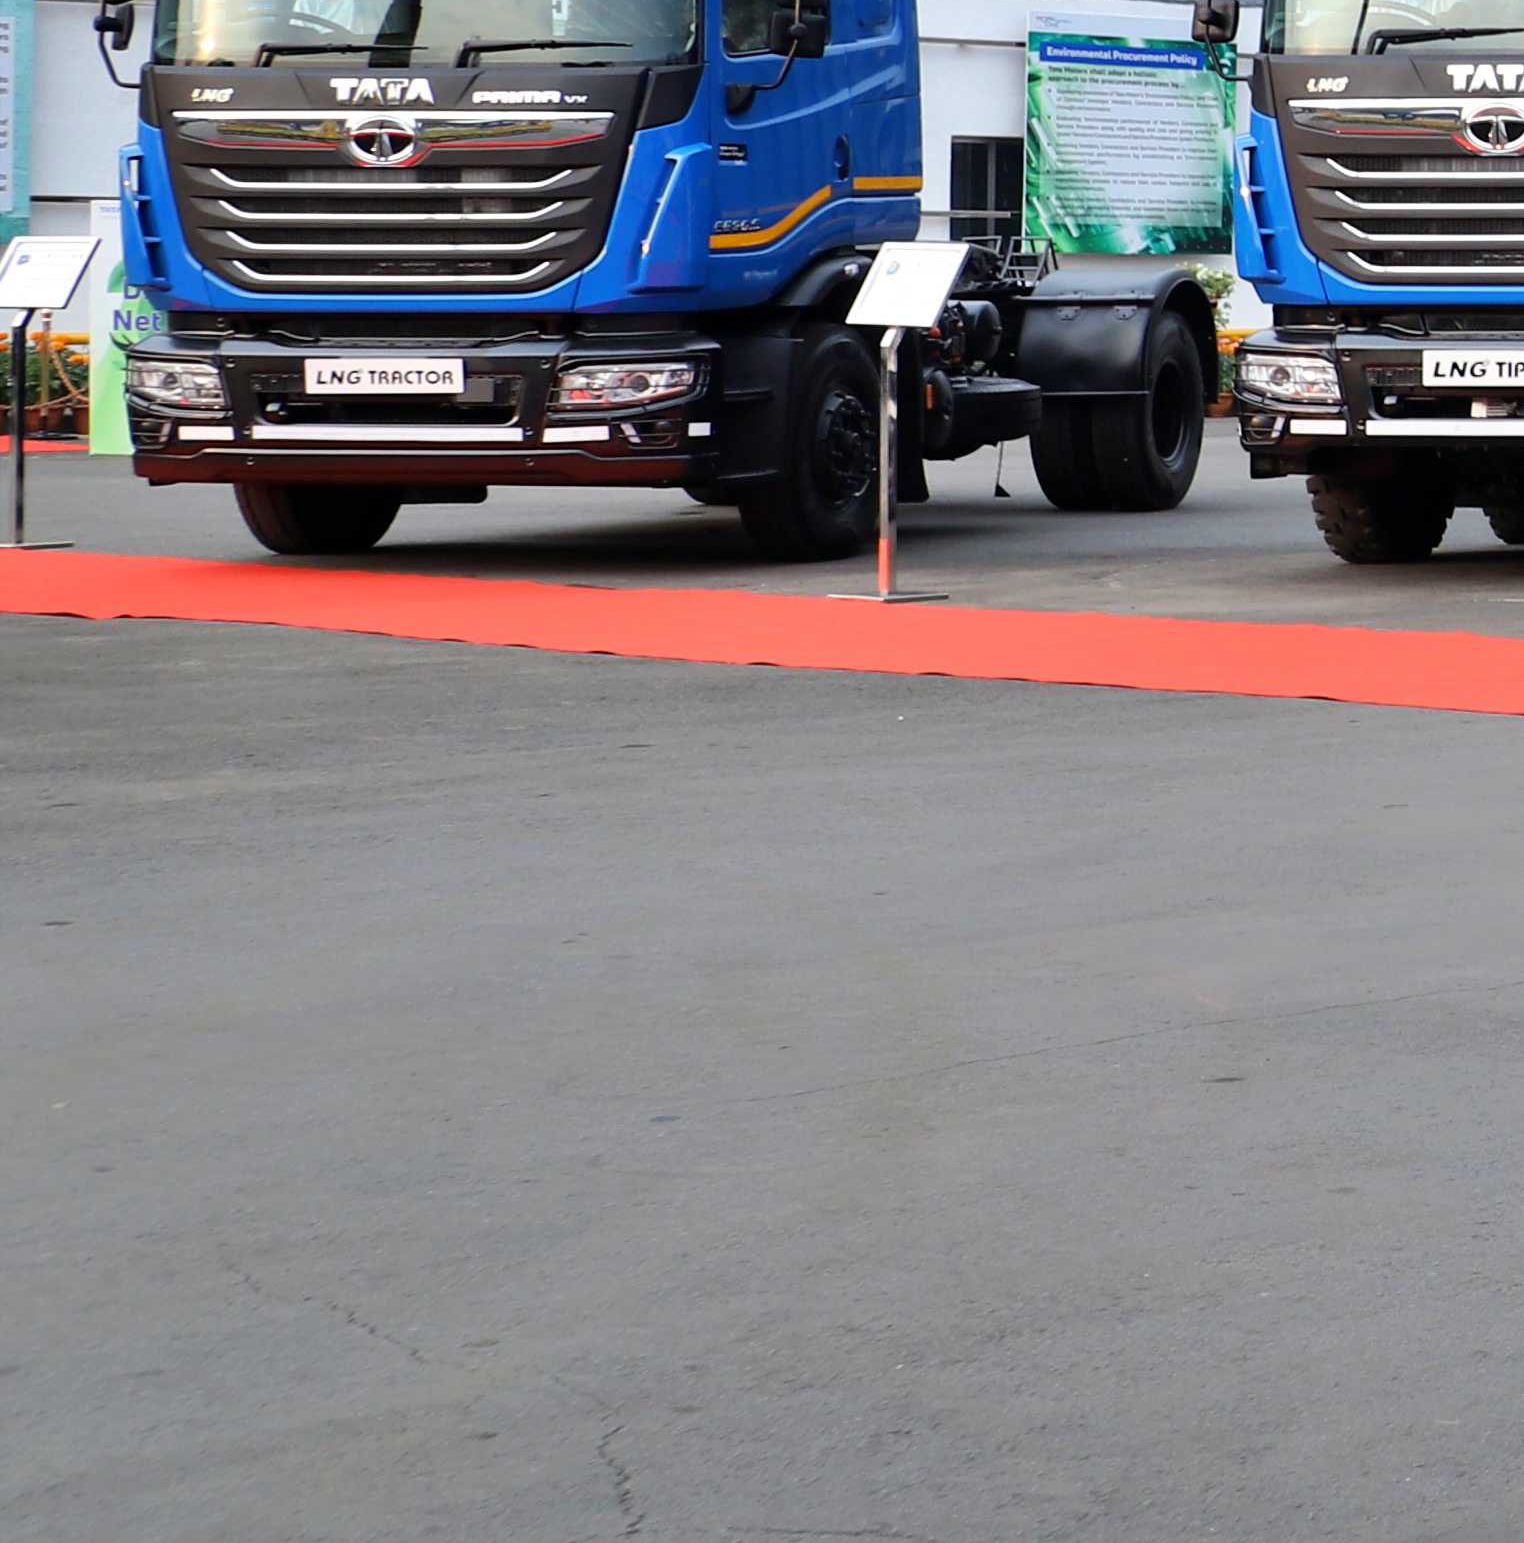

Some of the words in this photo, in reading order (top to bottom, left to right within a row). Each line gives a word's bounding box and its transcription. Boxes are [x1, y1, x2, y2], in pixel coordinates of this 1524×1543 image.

[1046, 46, 1113, 60] Environmental
[1113, 51, 1170, 63] Procurement
[1170, 53, 1198, 66] Policy
[330, 78, 435, 105] TATA
[1307, 76, 1349, 92] LNG
[191, 88, 235, 102] LNG
[471, 90, 562, 104] PRIMA
[316, 369, 362, 385] LNG
[368, 370, 454, 385] TRACTOR
[1433, 361, 1488, 379] LNG
